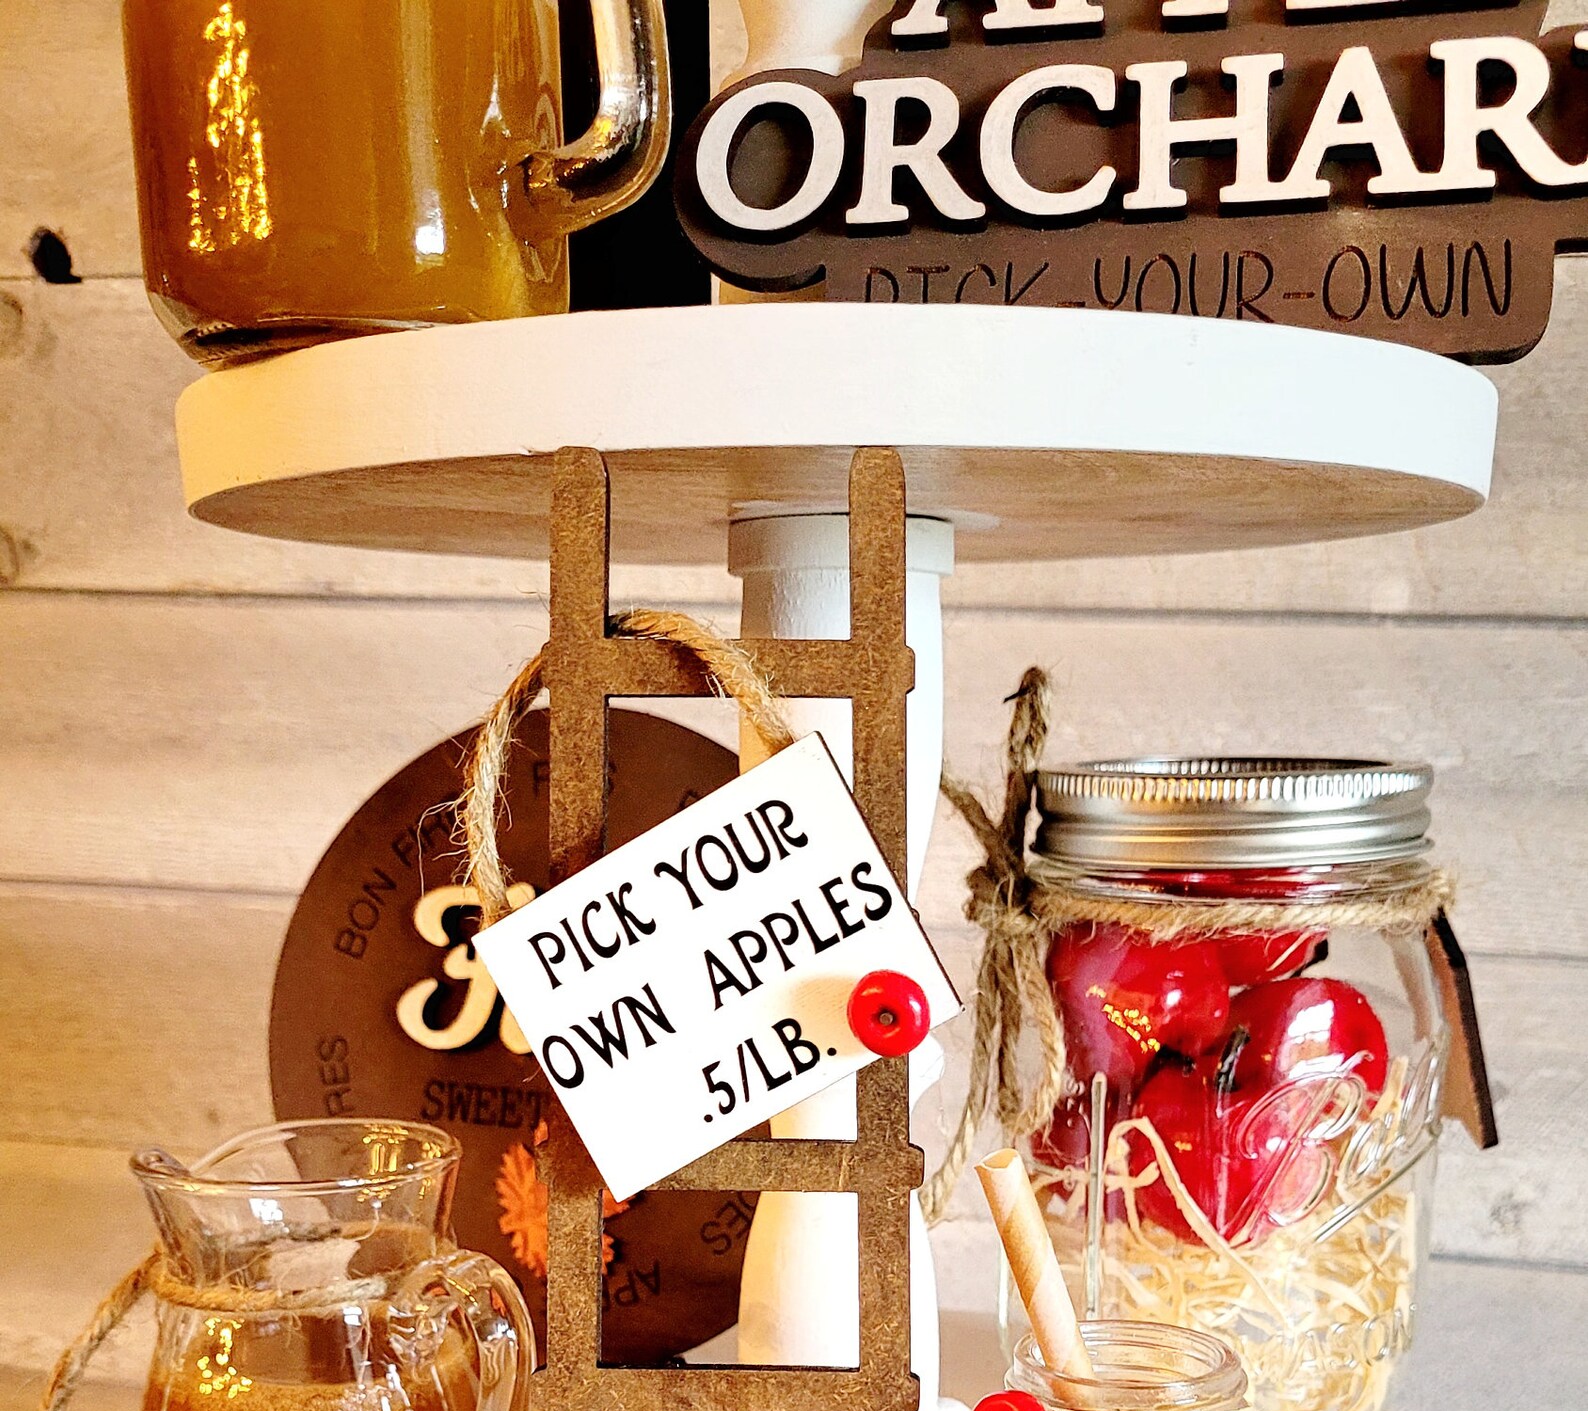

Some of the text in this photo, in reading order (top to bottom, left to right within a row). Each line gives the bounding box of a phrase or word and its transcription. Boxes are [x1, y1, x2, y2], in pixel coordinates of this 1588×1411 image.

[695, 35, 1588, 231] ORCHAR
[335, 866, 397, 960] BON
[527, 800, 808, 990] PICK YOUR
[541, 861, 893, 1089] OWN APPLES
[702, 1017, 837, 1123] .5/LB.
